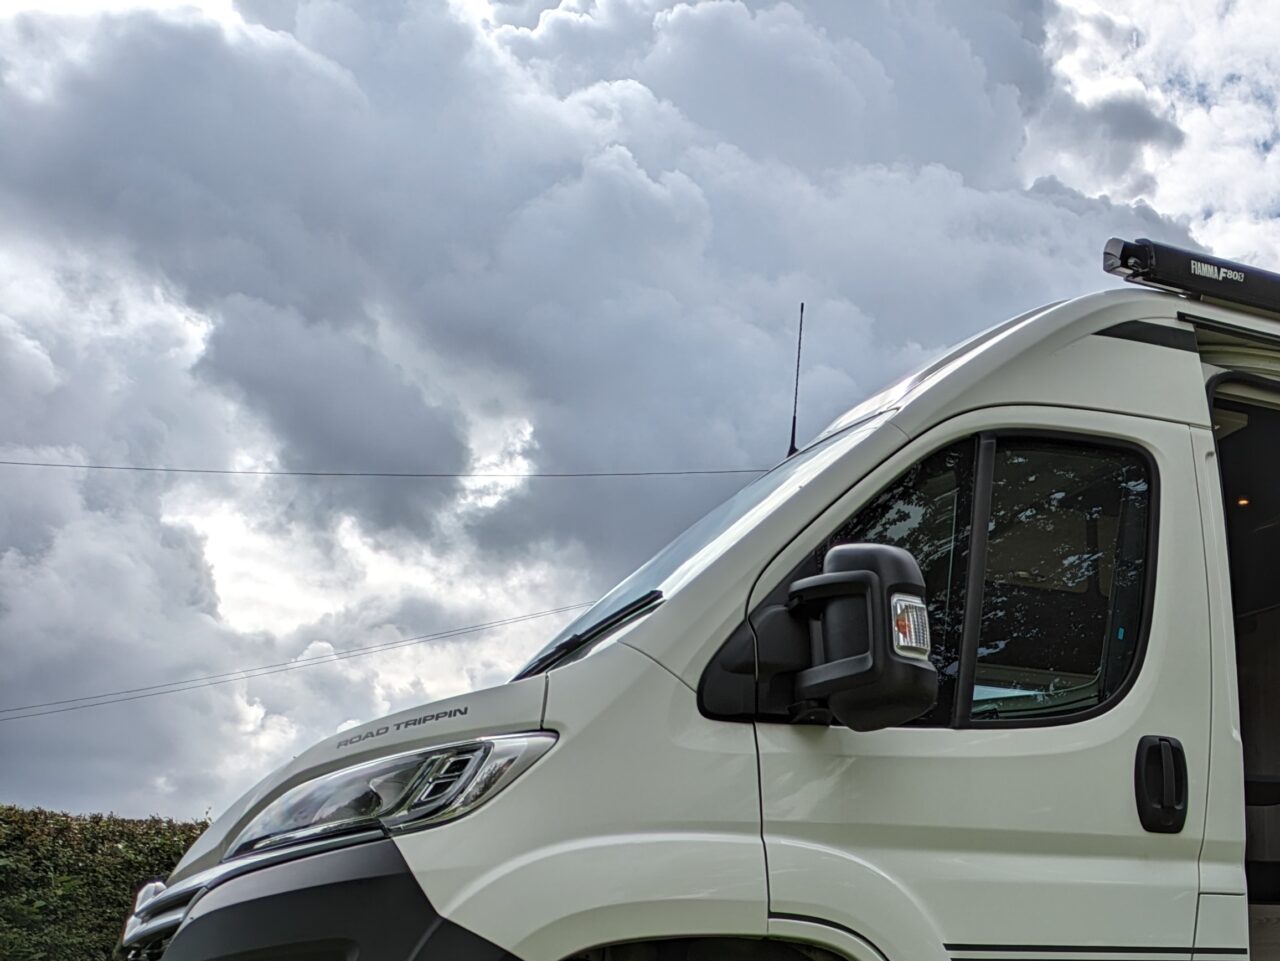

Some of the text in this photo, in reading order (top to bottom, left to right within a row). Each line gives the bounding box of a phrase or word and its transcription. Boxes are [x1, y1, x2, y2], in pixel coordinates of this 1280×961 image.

[1190, 259, 1219, 280] FIAMMA
[336, 706, 469, 749] ROAD TRIPPIN
